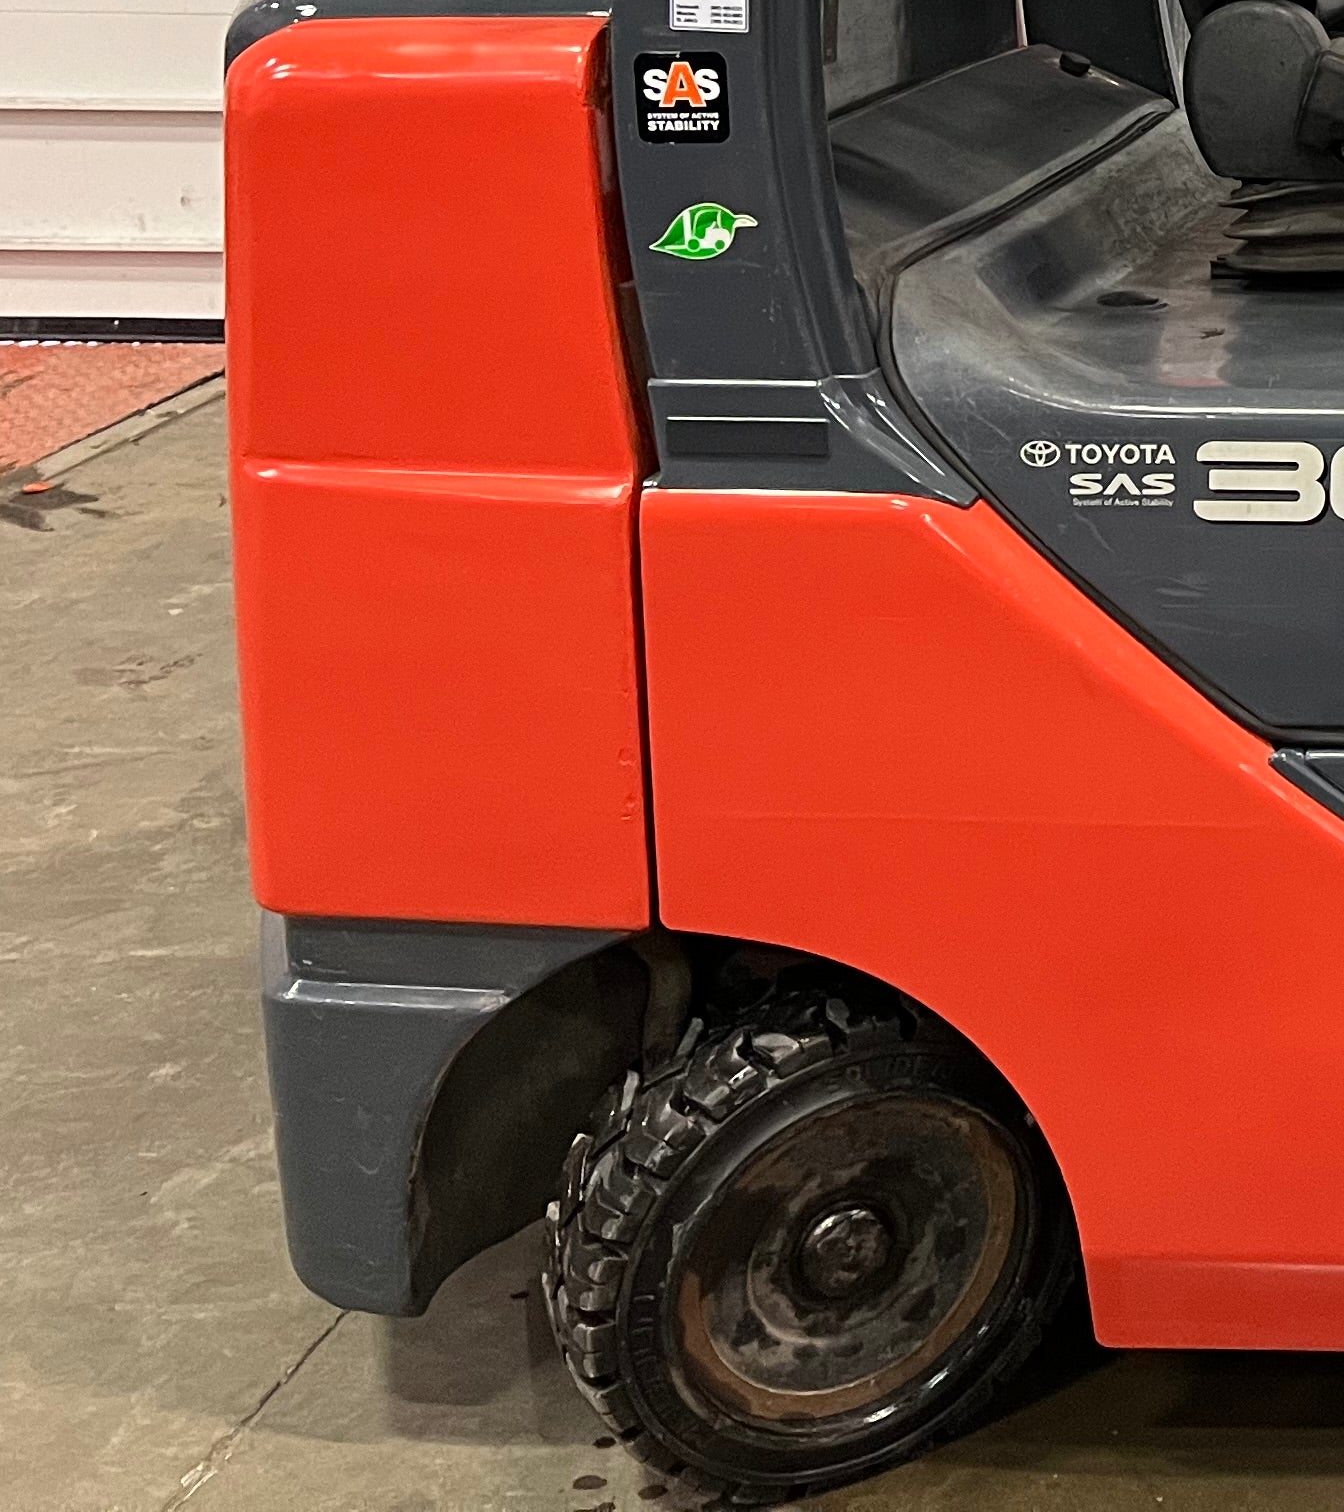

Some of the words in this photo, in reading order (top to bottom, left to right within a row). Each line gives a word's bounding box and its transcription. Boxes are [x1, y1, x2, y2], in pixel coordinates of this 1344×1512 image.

[643, 61, 721, 108] SAS
[647, 120, 720, 131] STABILITY
[1065, 444, 1176, 465] TOYOTA
[1069, 473, 1176, 496] SAS
